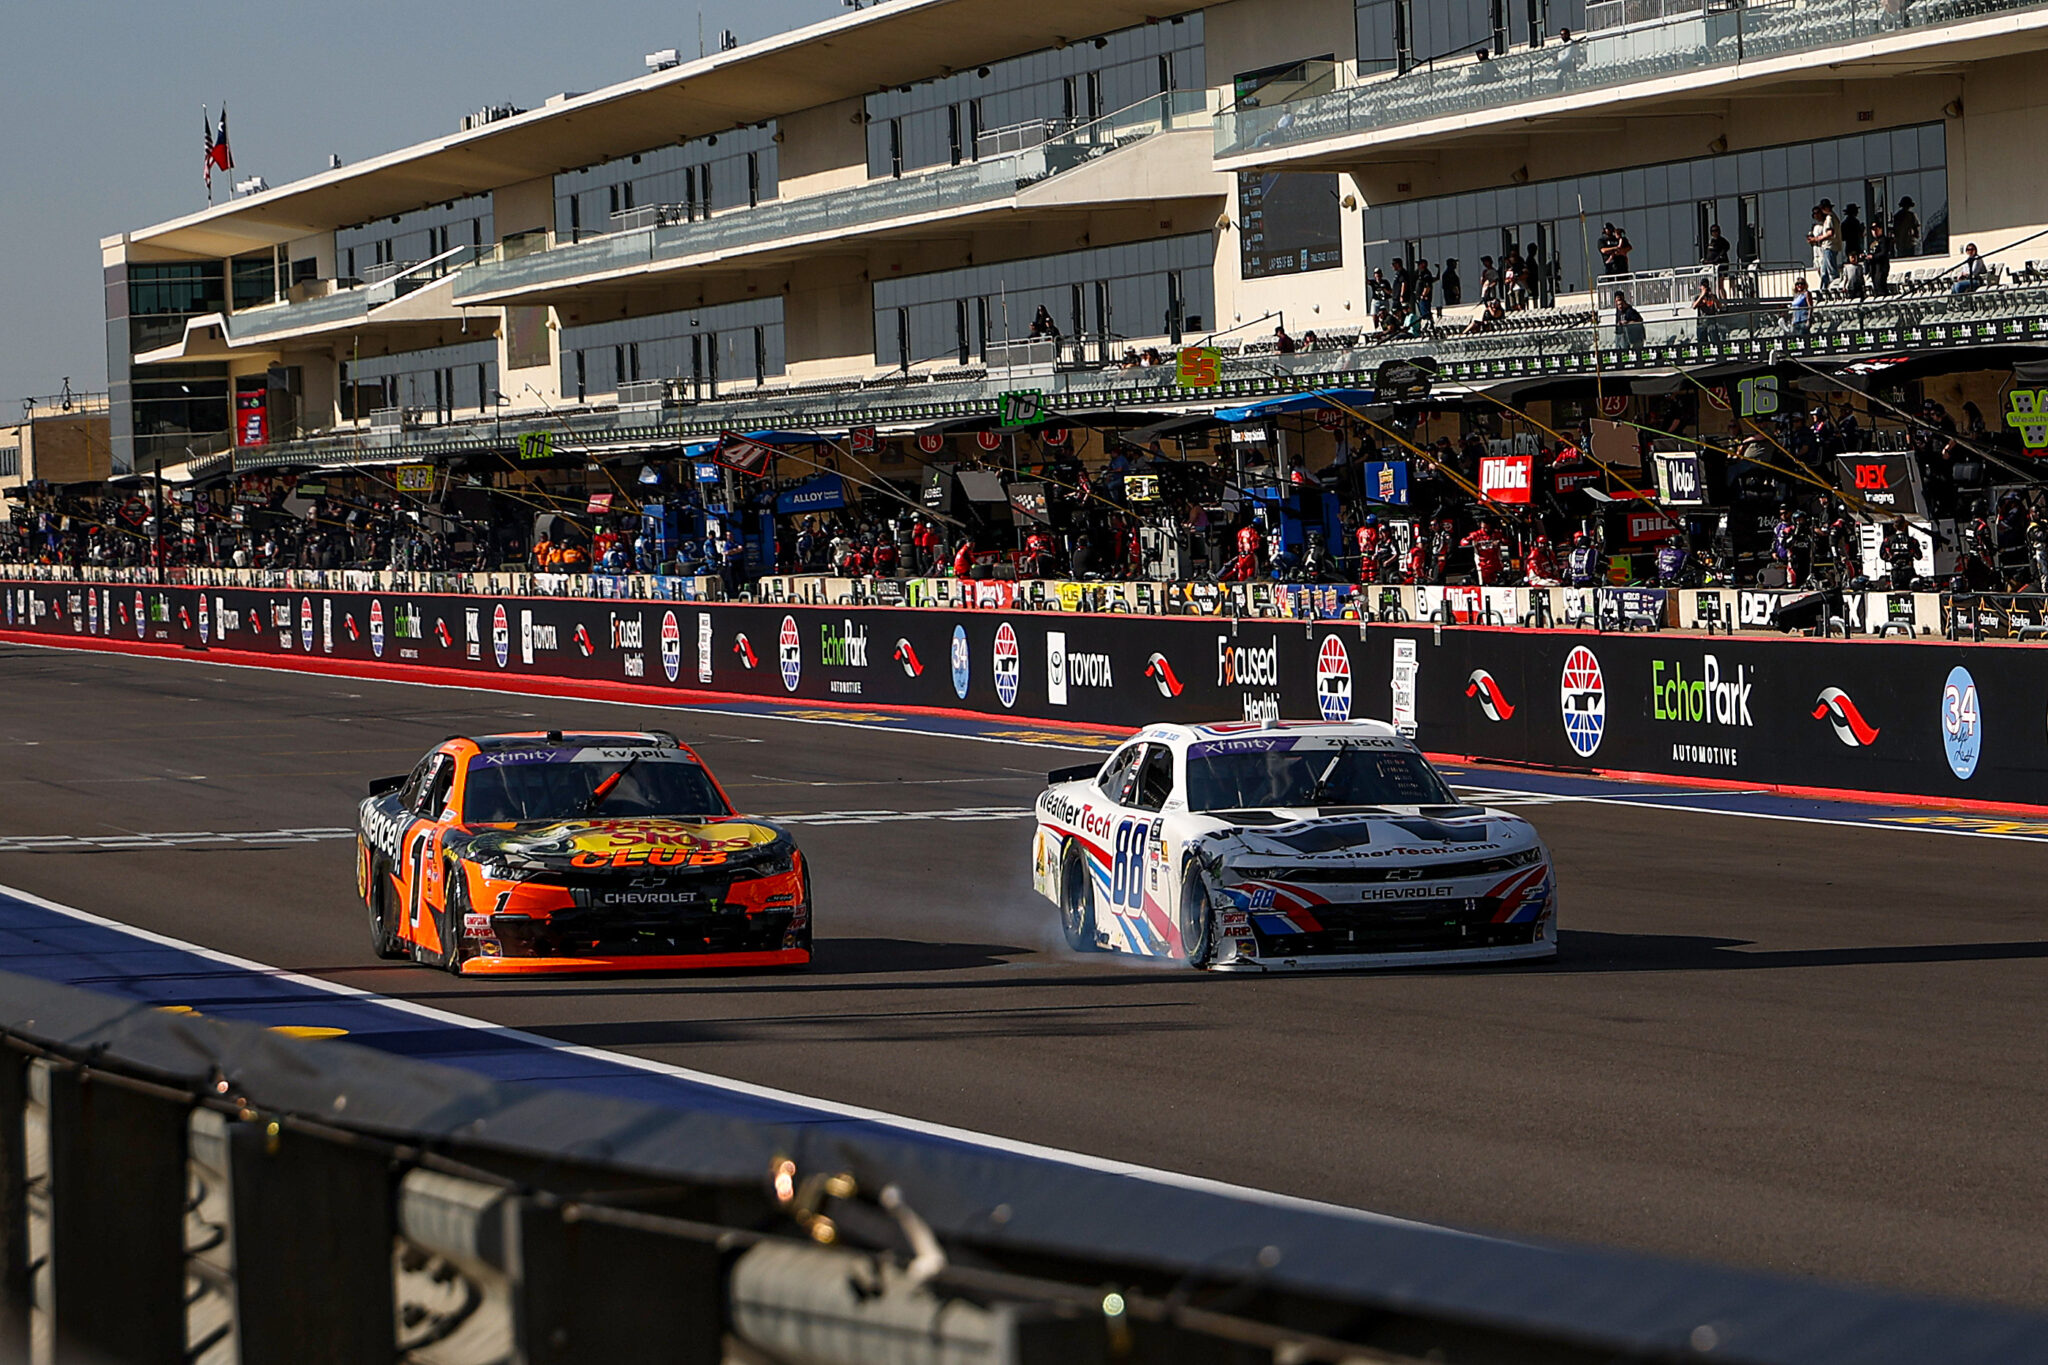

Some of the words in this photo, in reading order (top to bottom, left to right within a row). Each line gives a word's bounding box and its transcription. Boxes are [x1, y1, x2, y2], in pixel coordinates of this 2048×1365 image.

[1006, 394, 1038, 420] 10
[723, 442, 765, 468] 41
[1669, 461, 1695, 498] Volpi
[1855, 464, 1889, 489] DEX
[793, 492, 823, 504] ALLOY
[1740, 592, 1777, 626] DEX
[532, 624, 558, 650] TOYOTA
[610, 611, 643, 650] Focused
[821, 618, 868, 667] EchoPark
[952, 637, 968, 668] 34
[1217, 634, 1278, 687] Focused
[1068, 652, 1113, 688] TOYOTA
[1652, 654, 1754, 727] EchoPark
[1243, 692, 1280, 722] Health
[1945, 684, 1977, 737] 34
[603, 749, 672, 760] KVAPIL
[1204, 737, 1276, 754] xfinity
[1325, 738, 1395, 748] ZILISCH
[1672, 743, 1738, 767] AUTOMOTIVE
[486, 750, 557, 766] xfinity
[1038, 788, 1111, 840] WeatherTech
[570, 847, 728, 868] CLUB
[1110, 815, 1151, 919] 88
[409, 828, 431, 929] 1
[494, 890, 512, 913] 1
[604, 892, 697, 905] CHEVROLET
[1249, 888, 1277, 911] 88
[1361, 886, 1454, 901] CHEVROLET
[1224, 926, 1250, 937] ARP
